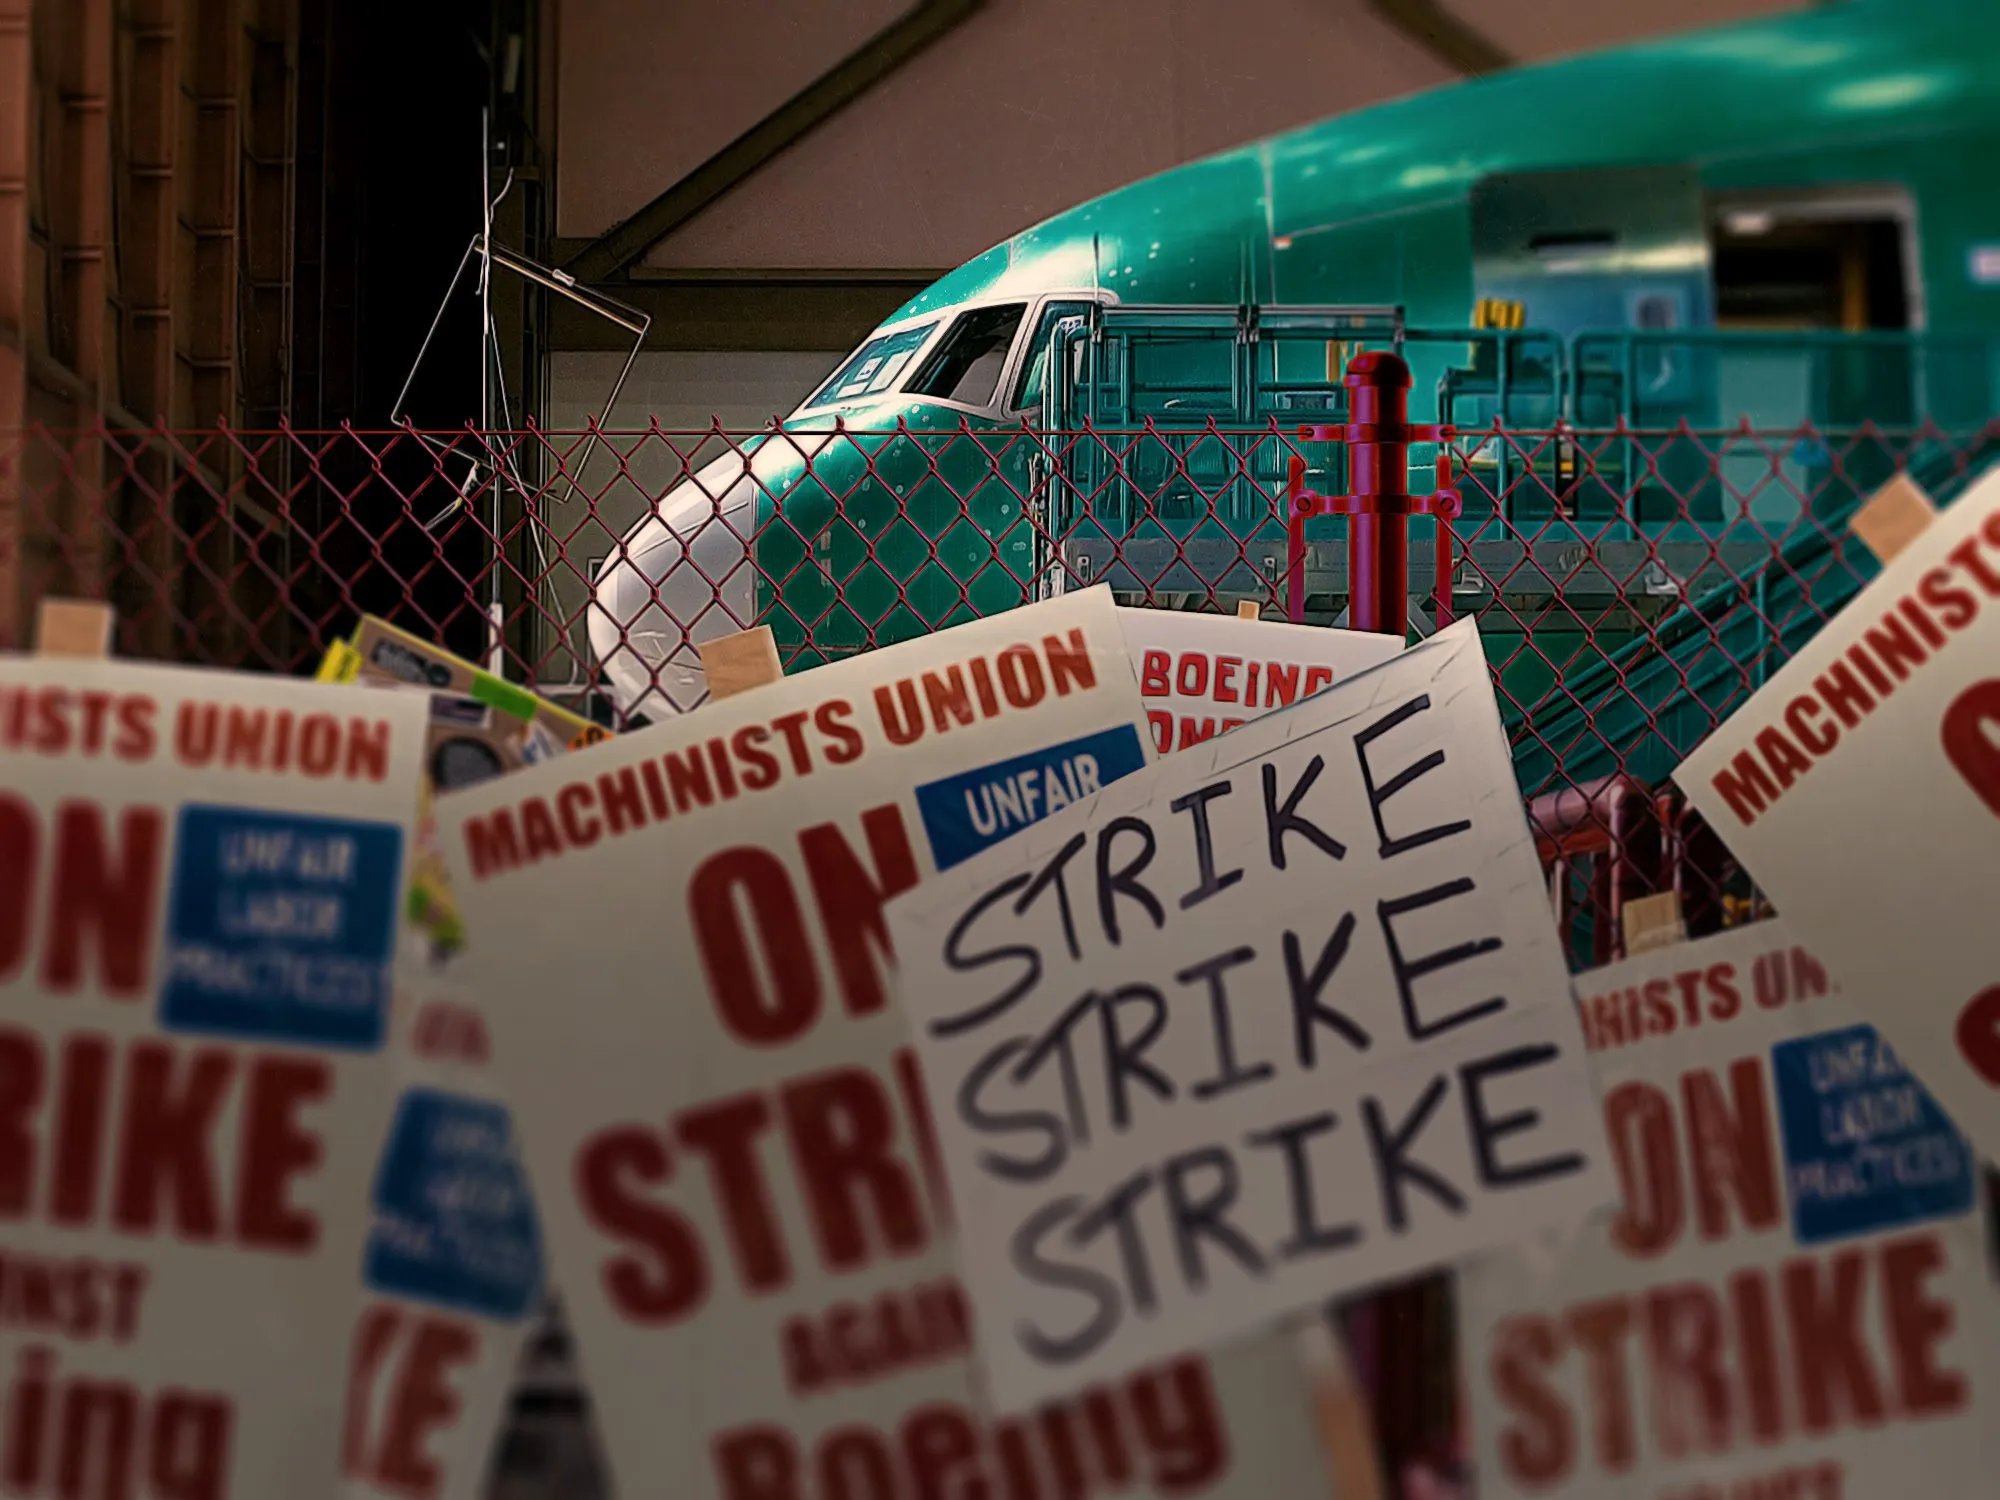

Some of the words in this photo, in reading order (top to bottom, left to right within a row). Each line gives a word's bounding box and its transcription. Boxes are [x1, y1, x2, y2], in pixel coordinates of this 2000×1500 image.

[0, 685, 158, 764] ISTS
[172, 696, 391, 784] UNION
[462, 699, 866, 882] MACHINISTS
[872, 627, 1098, 747] UNION
[964, 753, 1103, 836] UNFAIR
[686, 800, 922, 1051] ON
[927, 693, 1473, 1040] STRIKE
[956, 877, 1507, 1183] STRIKE
[1008, 1042, 1588, 1367] STRIKE
[1603, 1054, 1782, 1262] ON
[1488, 1232, 1972, 1490] STRIKE
